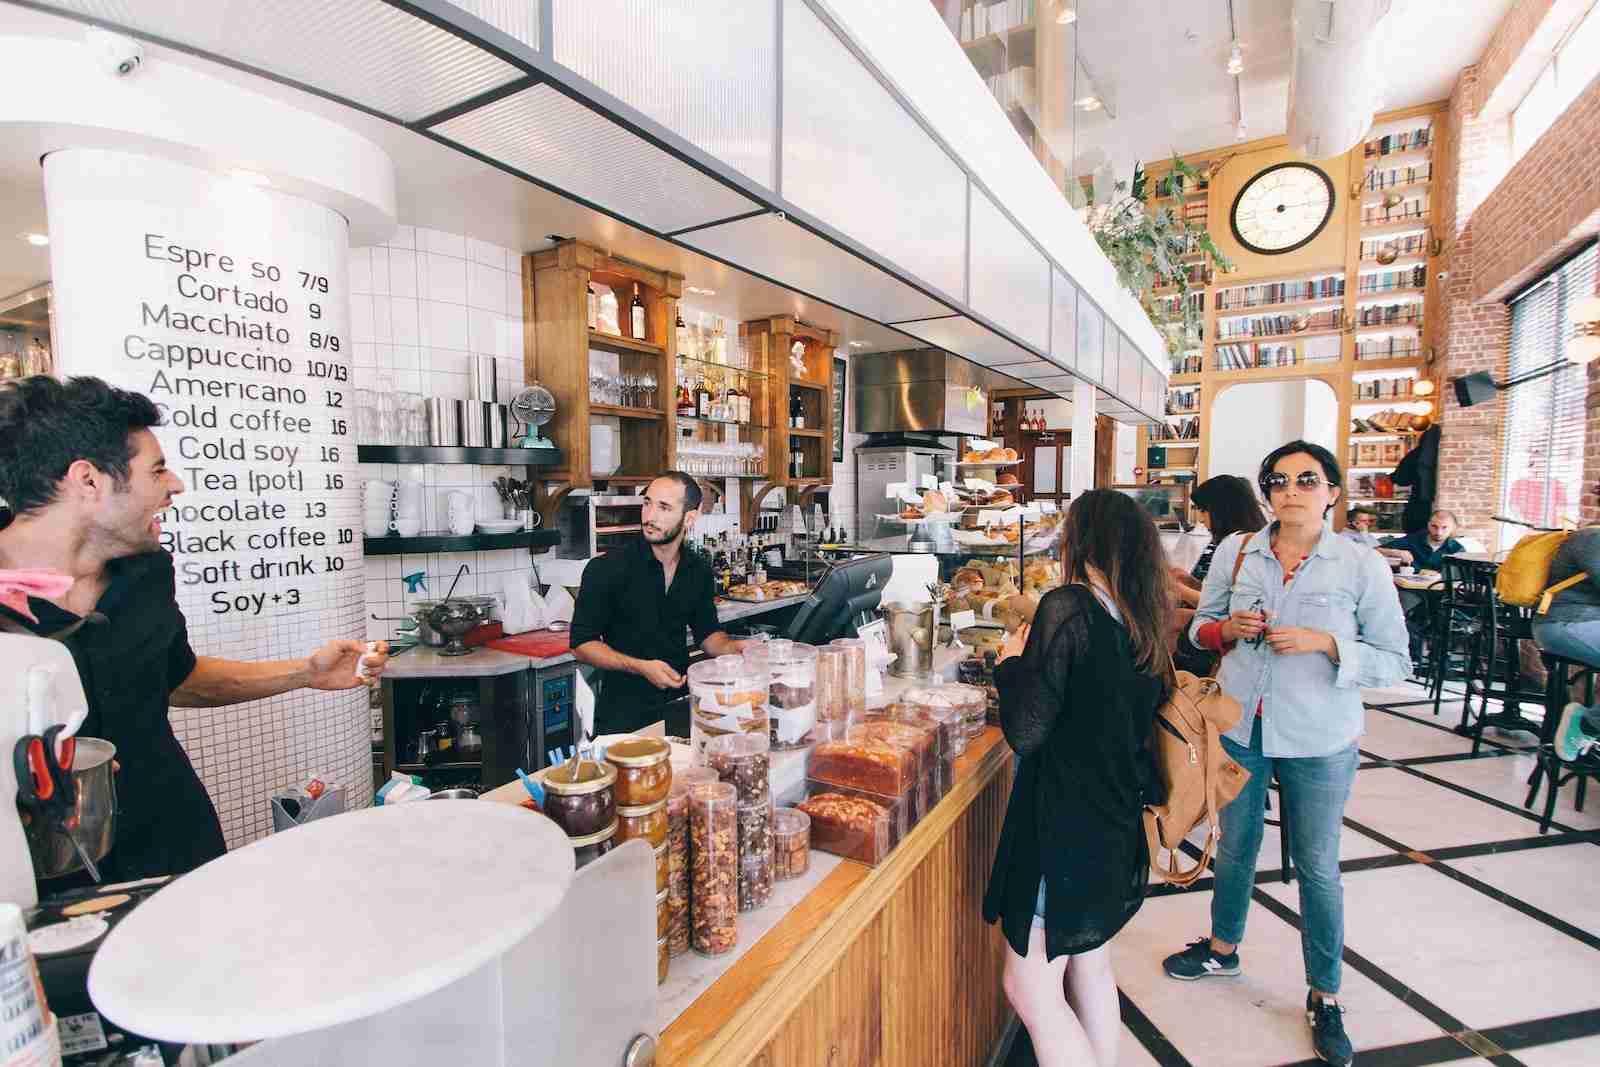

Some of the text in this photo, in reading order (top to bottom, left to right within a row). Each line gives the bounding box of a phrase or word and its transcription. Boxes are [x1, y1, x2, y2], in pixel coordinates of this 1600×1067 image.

[176, 273, 322, 320] Cortado 9
[297, 270, 330, 294] 7/9
[141, 301, 341, 353] Macchiato 8/9
[123, 334, 348, 382] Cappuccino 10/13
[149, 368, 343, 409] Americano 12
[229, 409, 312, 434] coffee
[330, 418, 348, 437] 16
[178, 435, 340, 468] Cold soy 16
[182, 466, 238, 492] Tea
[324, 473, 344, 492] 16
[160, 500, 327, 524] hocolate 13
[247, 525, 326, 551] coffee
[337, 527, 354, 545] 10
[181, 553, 345, 587] Soft drink 10
